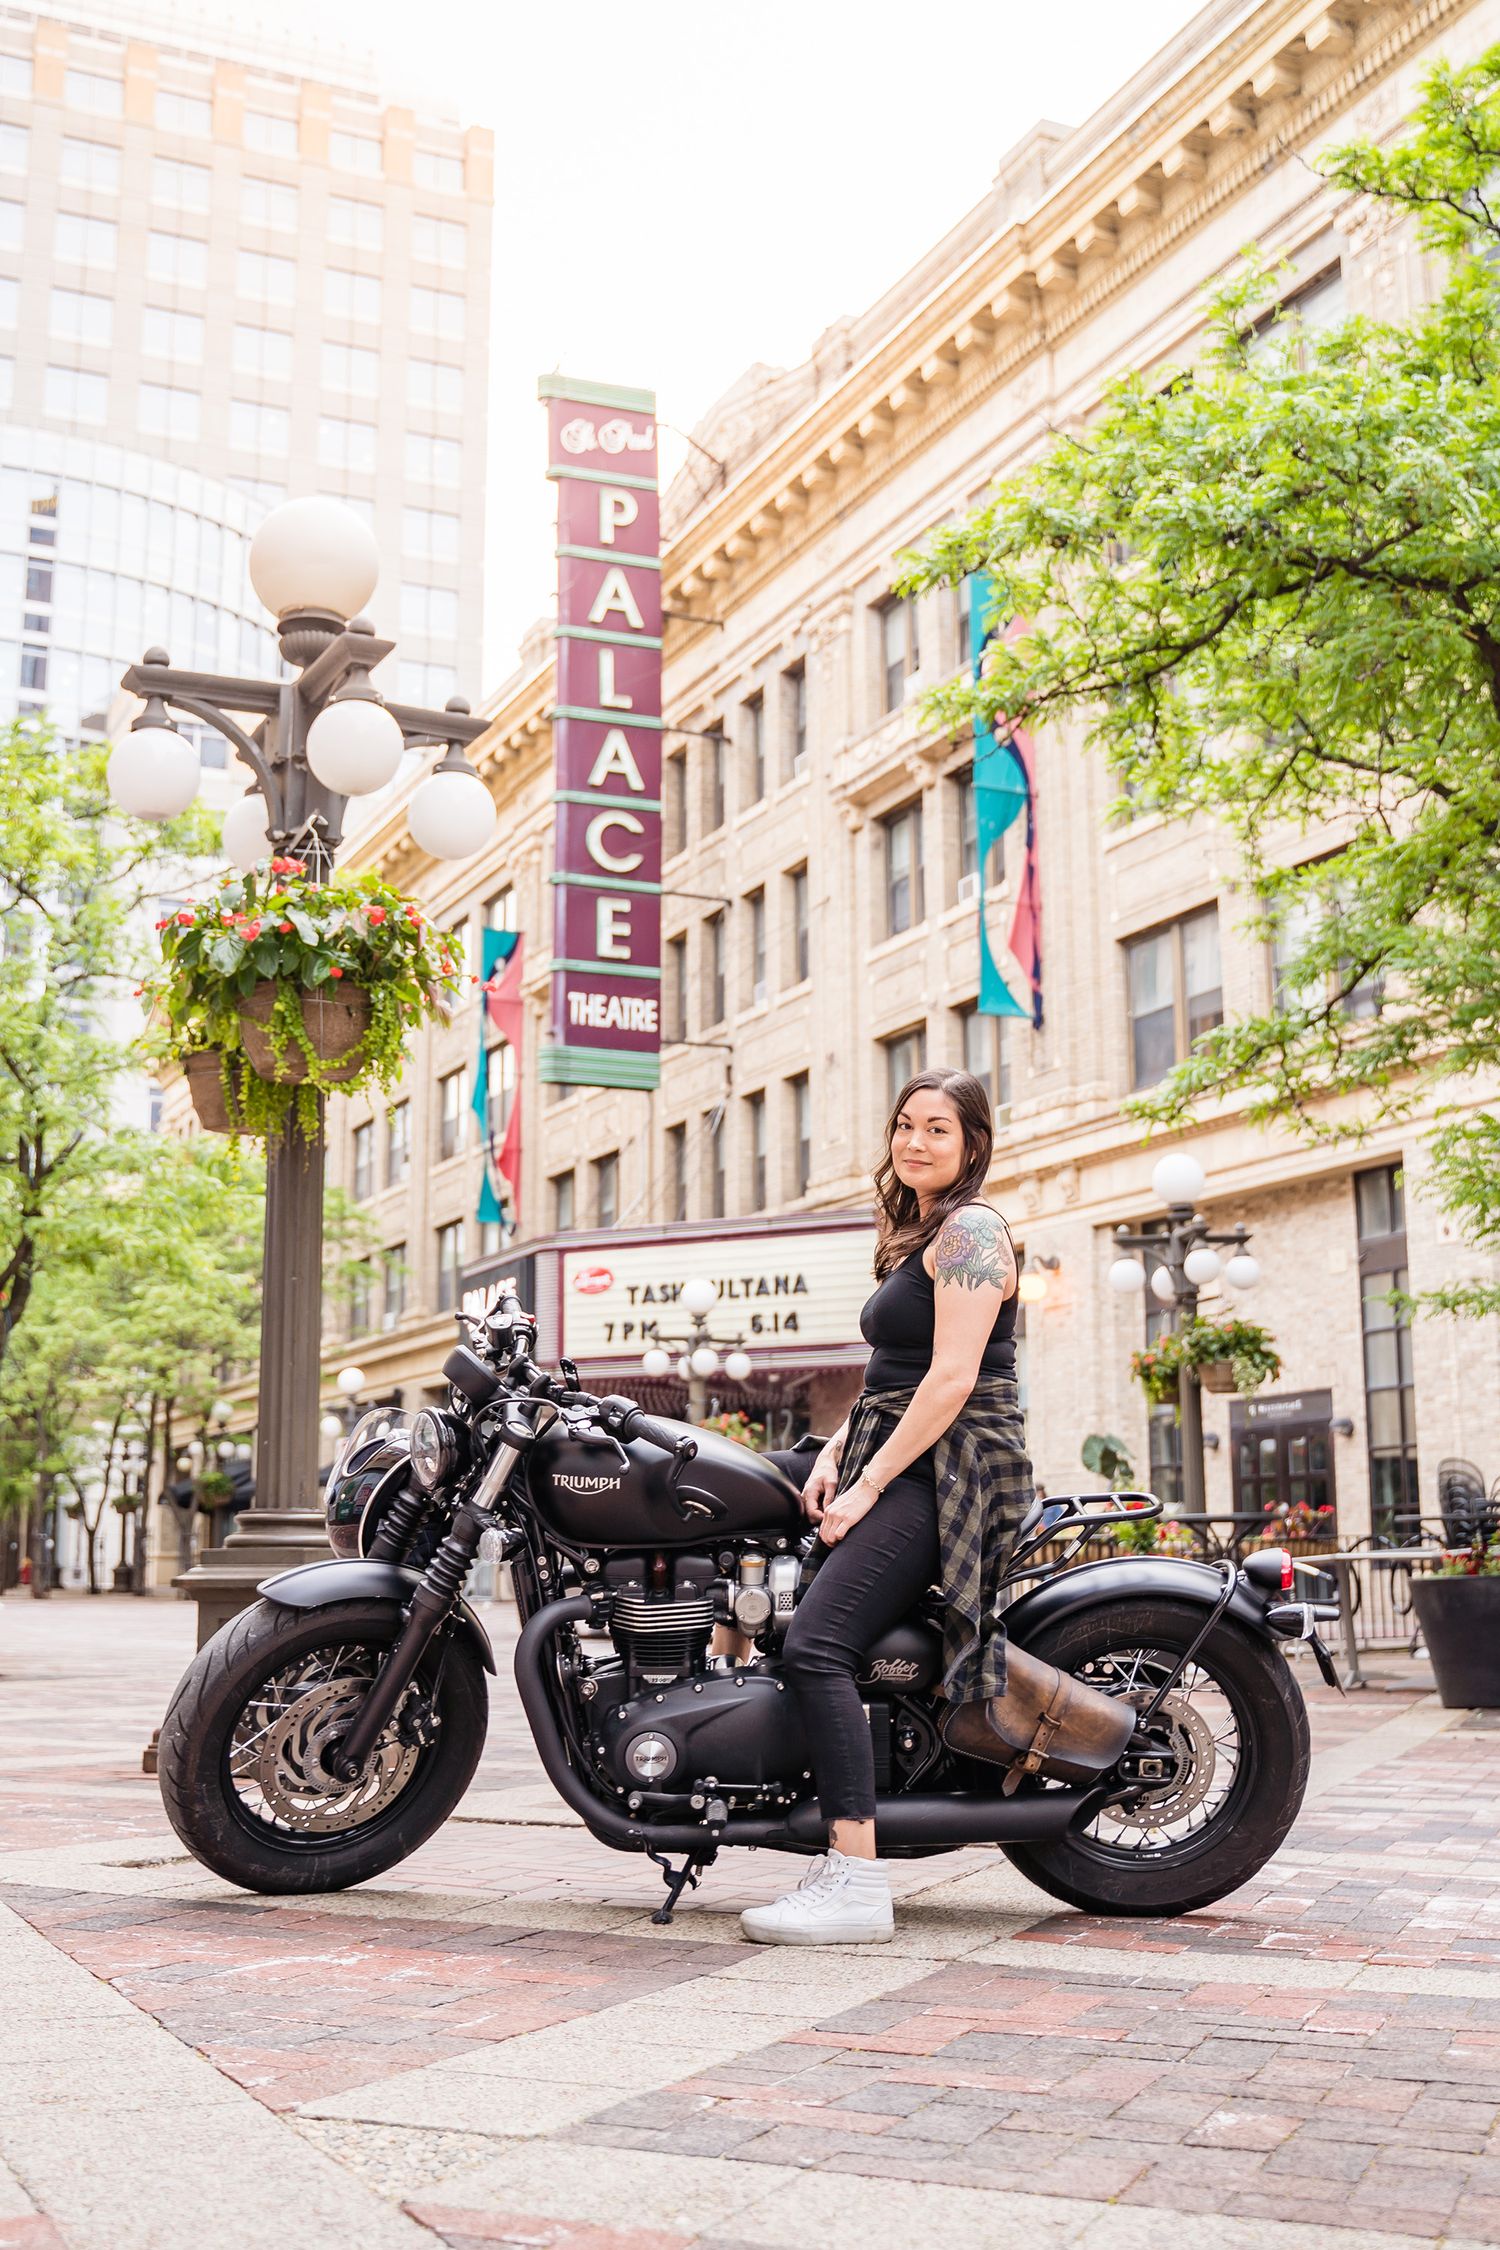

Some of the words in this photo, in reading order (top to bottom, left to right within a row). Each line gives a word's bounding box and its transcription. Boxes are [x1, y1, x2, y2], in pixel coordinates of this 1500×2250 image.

[585, 486, 647, 960] PALACE
[567, 991, 658, 1033] THEATRE
[751, 1311, 799, 1334] 6.14
[552, 1473, 621, 1495] TRIUMPH
[855, 1658, 919, 1684] Bobber
